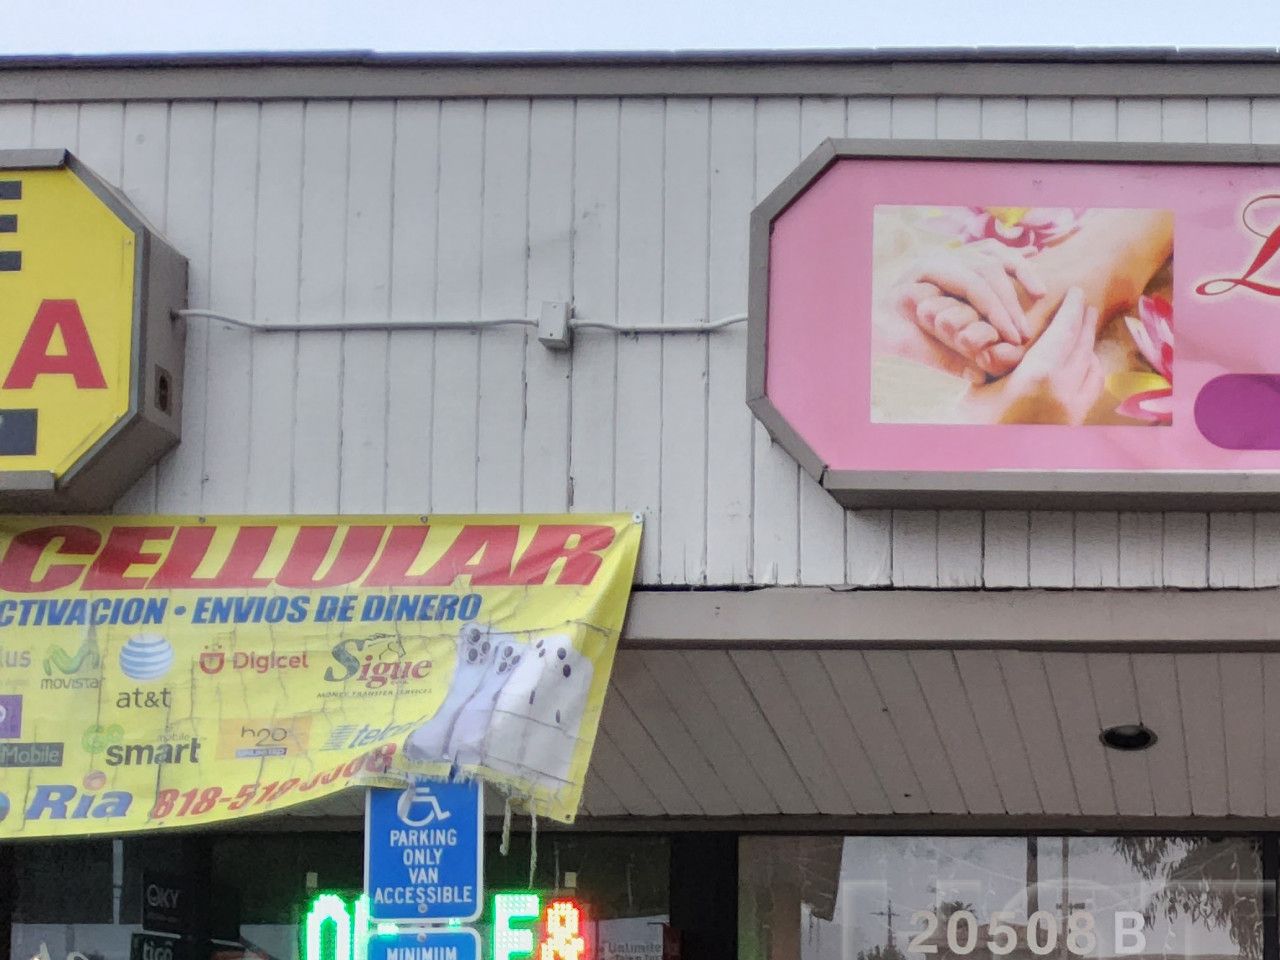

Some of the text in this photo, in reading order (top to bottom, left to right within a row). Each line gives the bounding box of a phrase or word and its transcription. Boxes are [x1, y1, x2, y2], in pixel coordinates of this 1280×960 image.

[1, 523, 616, 592] CELLULAR
[191, 596, 310, 624] ENVIOS
[314, 595, 358, 622] DE
[360, 593, 483, 622] DINERO
[323, 638, 432, 689] Sigue
[116, 687, 171, 709] at&t
[105, 737, 202, 767] smart
[24, 769, 133, 820] Ria
[389, 828, 458, 848] PARKING
[403, 848, 444, 866] ONLY
[408, 867, 439, 885] VAN
[374, 886, 473, 905] ACCESSIBLE
[907, 909, 1148, 955] 20508 B
